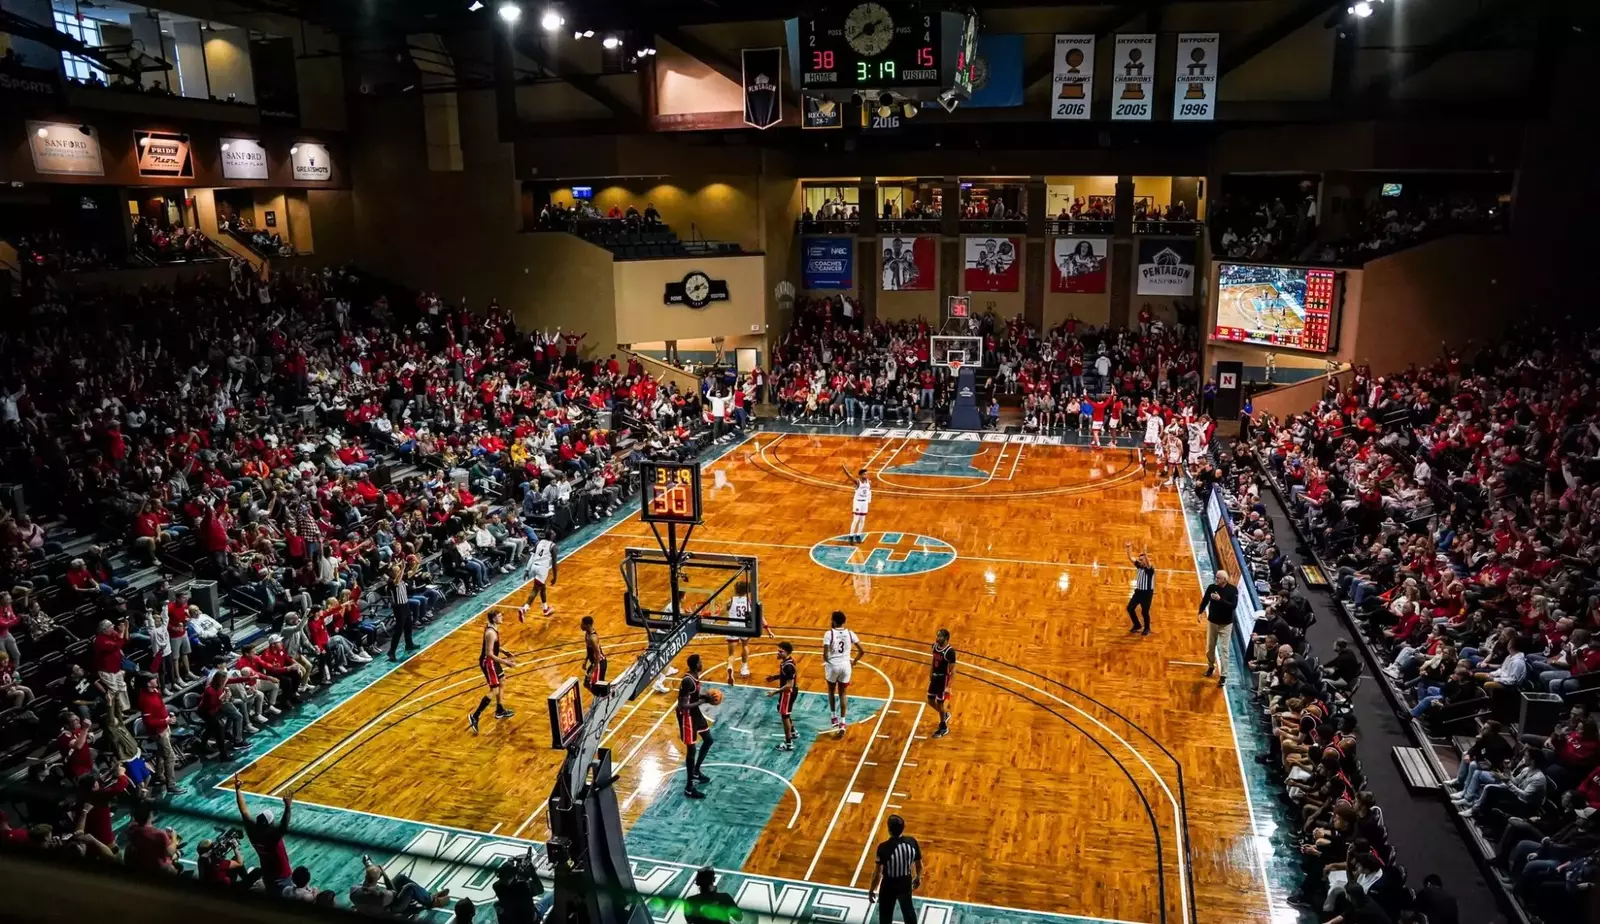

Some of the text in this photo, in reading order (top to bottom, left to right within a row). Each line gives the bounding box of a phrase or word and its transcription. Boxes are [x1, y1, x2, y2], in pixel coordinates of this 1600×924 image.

[810, 21, 815, 31] 1
[924, 16, 930, 27] 3
[809, 36, 816, 47] 2
[924, 32, 930, 42] 4
[813, 51, 834, 69] 38
[917, 48, 933, 66] 15
[857, 61, 895, 80] 3:19
[903, 70, 937, 80] VISITOR
[808, 72, 832, 82] HOME
[0, 73, 53, 94] SPORTS
[748, 84, 776, 92] PENTAGON
[1057, 104, 1085, 115] 2016
[1116, 104, 1148, 115] 2005
[1180, 104, 1208, 115] 1996
[873, 116, 899, 128] 2016
[45, 140, 87, 149] SANFORD
[226, 152, 262, 160] SANFORD
[1142, 265, 1191, 279] PENTAGON
[1223, 376, 1232, 385] N
[859, 428, 1062, 445] PENTAGON
[657, 468, 690, 484] 3:19
[654, 486, 687, 513] 30
[538, 549, 544, 557] 4
[736, 606, 747, 617] 53
[838, 641, 845, 654] 3
[650, 631, 688, 679] SANFORD
[372, 828, 956, 924] ENAON
